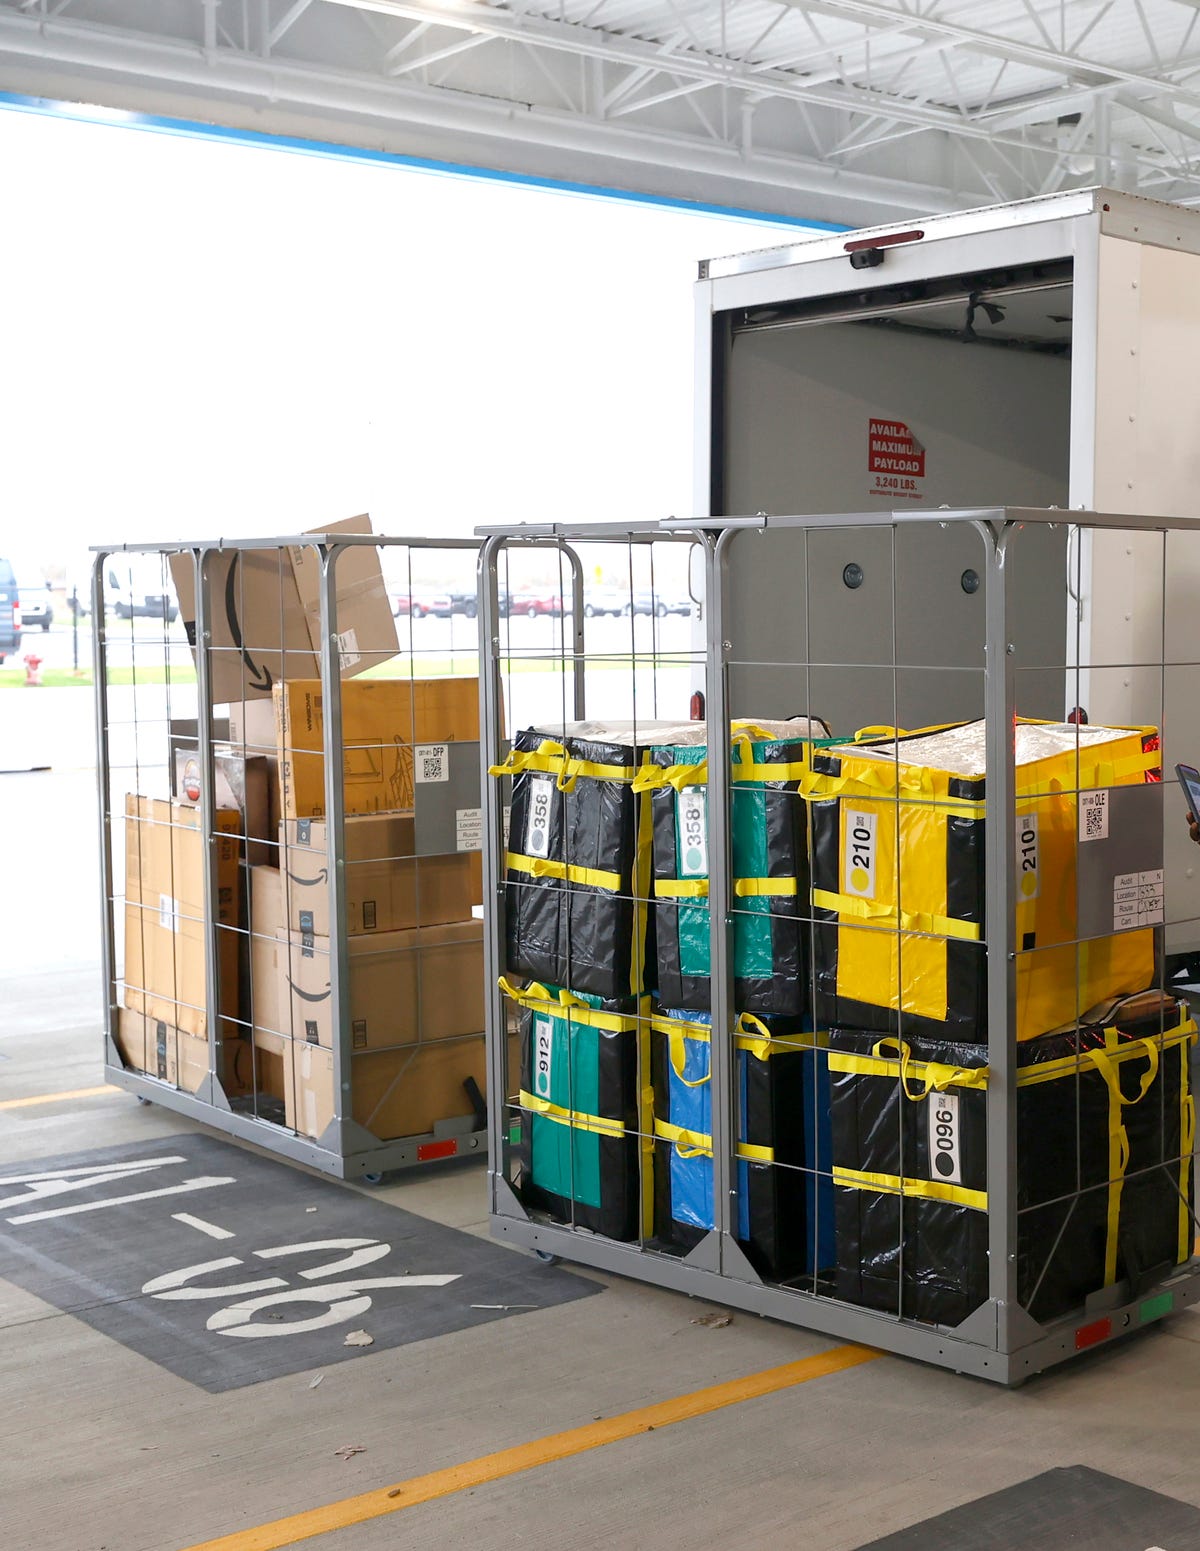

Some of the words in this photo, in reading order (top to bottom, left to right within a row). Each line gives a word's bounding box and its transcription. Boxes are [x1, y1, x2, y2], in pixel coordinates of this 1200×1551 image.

[870, 424, 911, 438] AVAILA
[874, 457, 919, 472] PAYLOAD
[875, 476, 898, 489] 3,240
[534, 794, 548, 829] 358
[686, 808, 701, 846] 358
[852, 828, 871, 869] 210
[1021, 830, 1036, 871] 210
[1120, 877, 1133, 886] Audit
[1116, 891, 1137, 900] Location
[1119, 905, 1133, 913] Route
[1121, 918, 1132, 926] Cart
[539, 1036, 549, 1072] 912
[936, 1110, 953, 1151] 096
